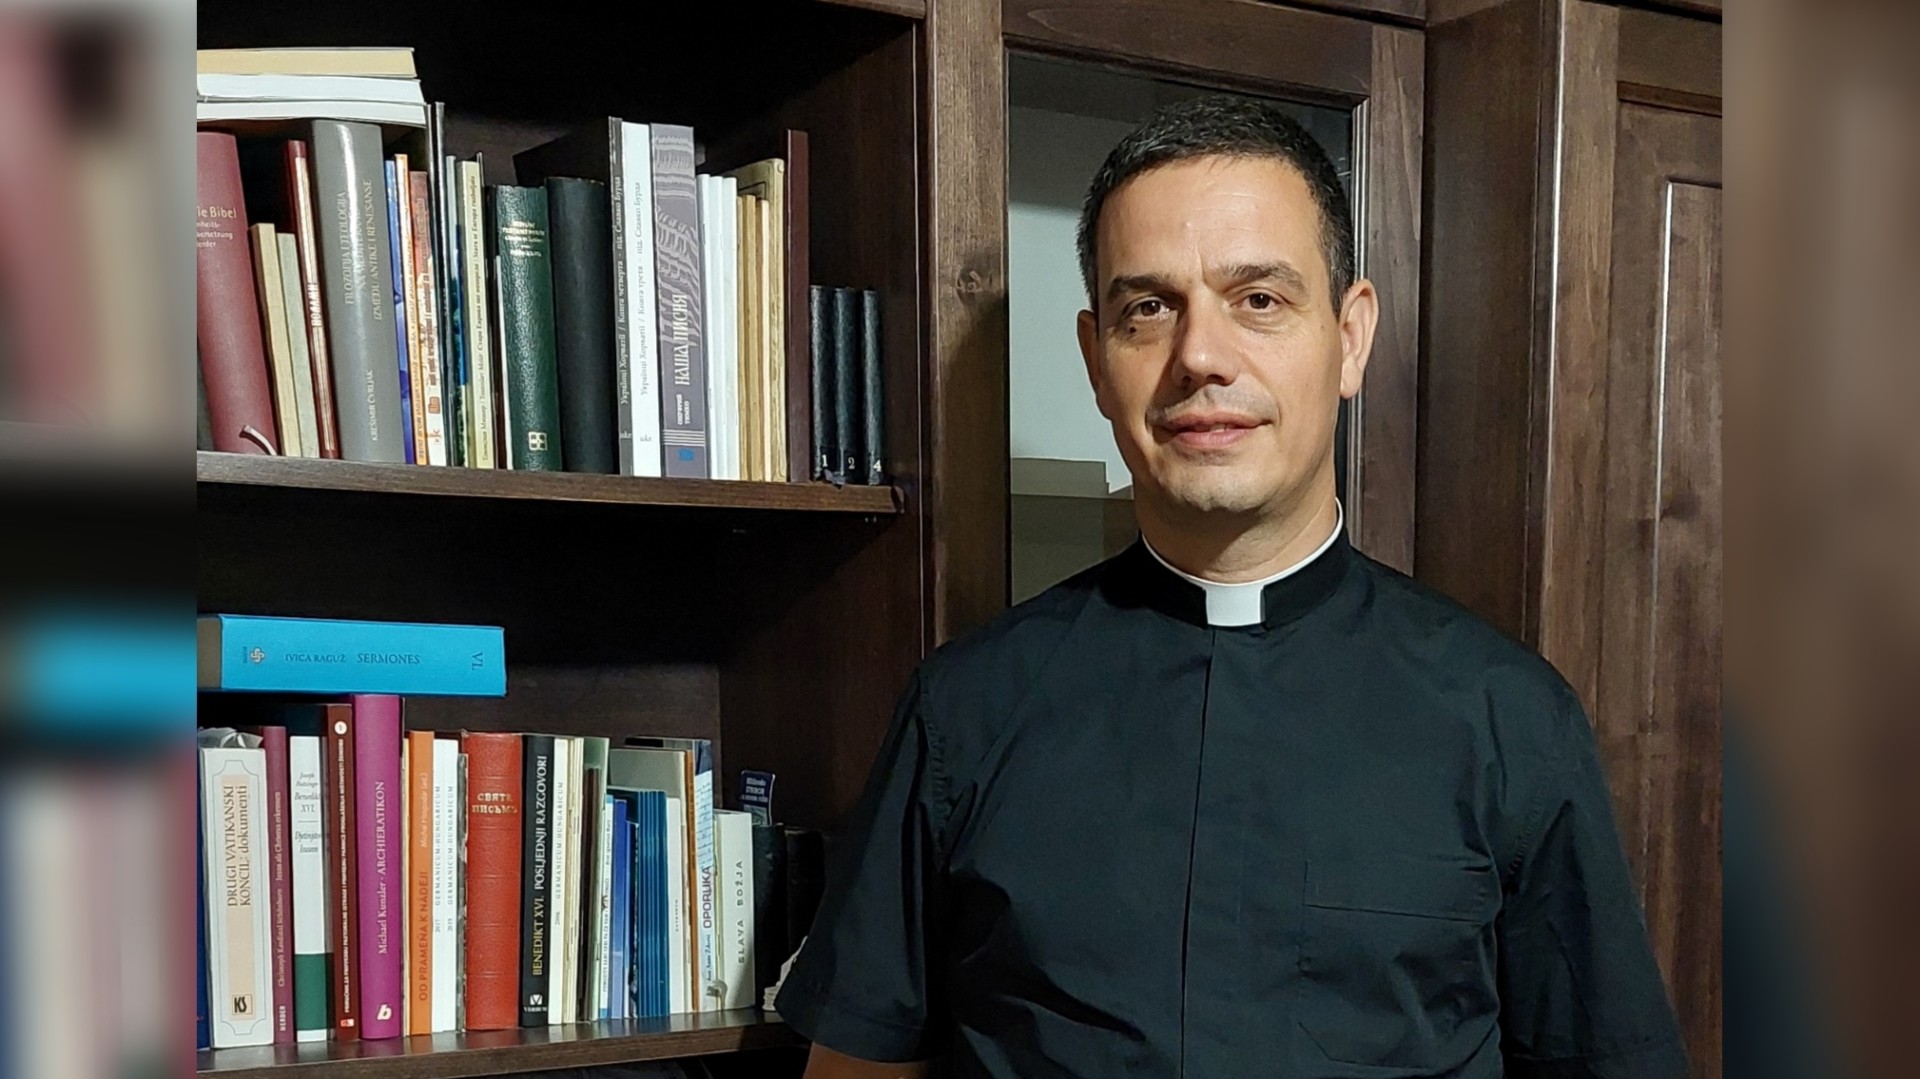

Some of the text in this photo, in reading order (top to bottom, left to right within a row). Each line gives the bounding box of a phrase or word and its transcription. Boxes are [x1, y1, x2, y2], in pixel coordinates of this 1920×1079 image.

[210, 205, 237, 219] Bibel
[338, 191, 351, 247] TEOLOGIJA
[363, 179, 377, 237] RENESANSE
[342, 252, 355, 305] FILOZOFIJA
[369, 243, 379, 280] ANTIKE
[618, 297, 626, 323] Книга
[672, 293, 690, 386] НАША ПИСНЯ
[620, 369, 629, 404] Українці
[822, 454, 828, 468] 1
[848, 457, 855, 469] 2
[873, 459, 882, 472] 4
[285, 652, 420, 664] IVICA RAGUŽ SERMONES
[224, 785, 238, 907] DRUGI VATIKANSKI
[237, 785, 251, 907] KONCIL: dokumenti
[375, 780, 387, 876] ARCHIERATIKON
[533, 755, 548, 976] BENEDIKT XVI. POSLJEDNJI RAZGOVORI
[377, 881, 388, 918] Kunzler
[702, 865, 712, 929] OPORUKA
[735, 859, 745, 964] SLAVA BOŽJA
[377, 919, 388, 955] Michael
[416, 870, 429, 1002] OD PRAMEŇA K NÁDEJI
